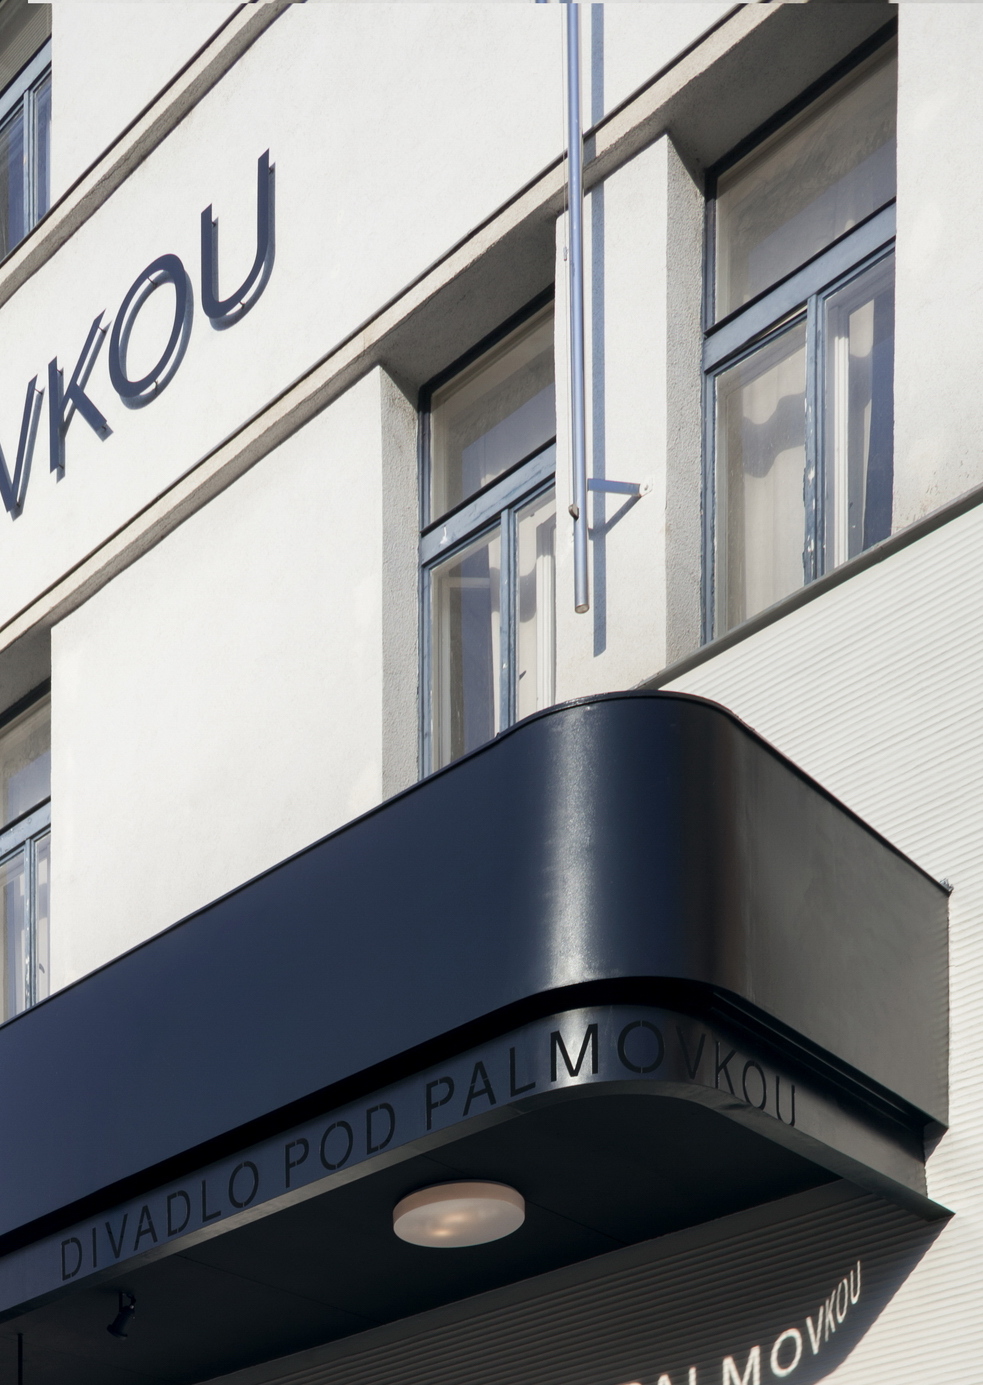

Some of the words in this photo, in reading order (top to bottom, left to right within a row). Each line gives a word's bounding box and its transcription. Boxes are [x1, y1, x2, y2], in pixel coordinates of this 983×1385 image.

[60, 1160, 260, 1282] DIVADLO
[284, 1102, 397, 1188] POD
[425, 1019, 799, 1130] PALMOVKOU
